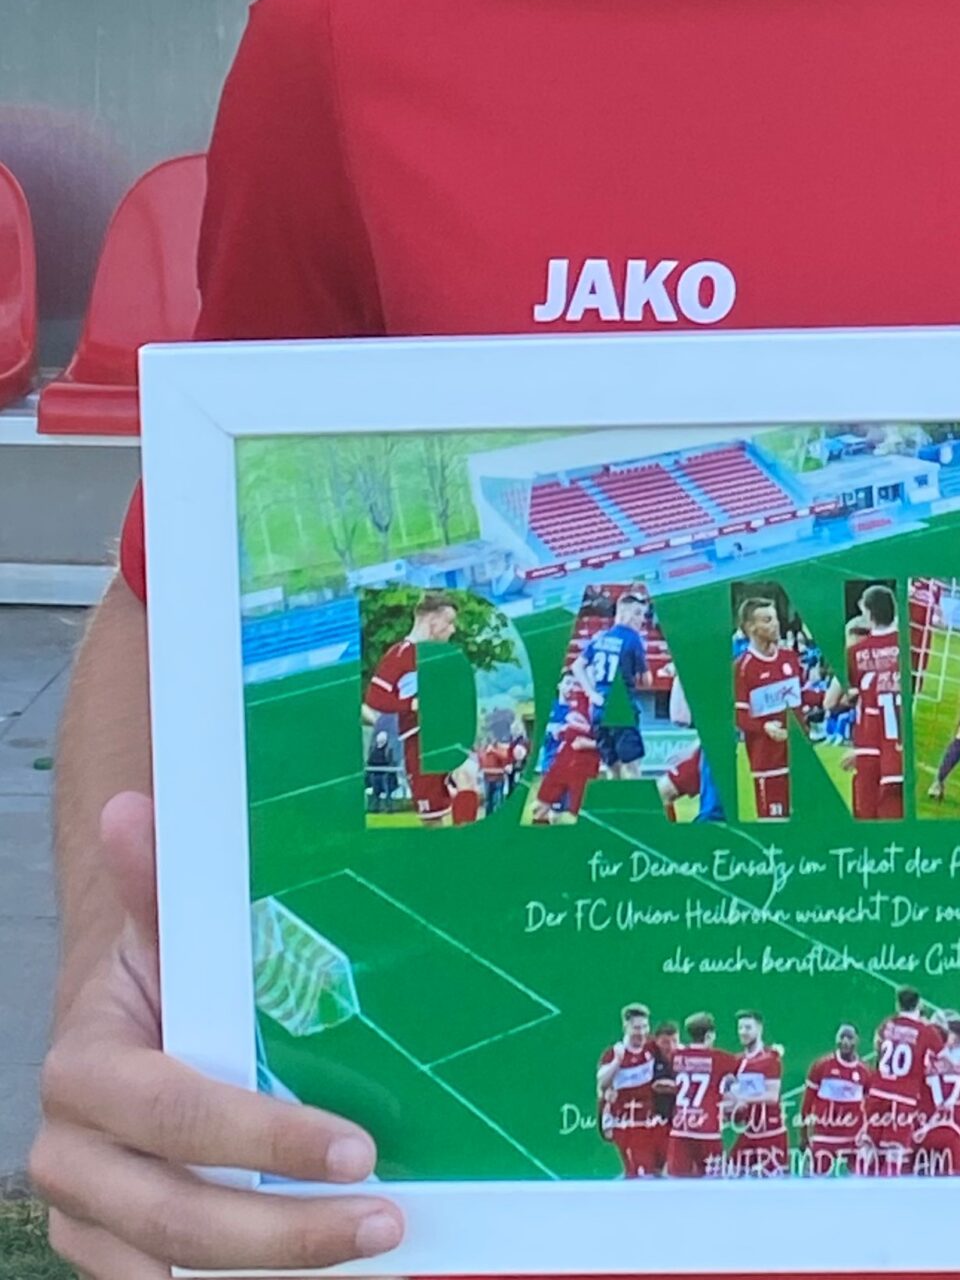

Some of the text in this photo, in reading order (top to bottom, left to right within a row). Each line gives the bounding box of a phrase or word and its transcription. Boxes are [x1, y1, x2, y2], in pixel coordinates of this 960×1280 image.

[533, 258, 737, 324] JAKO
[629, 850, 709, 883] Deinen
[712, 842, 796, 893] Einsatz
[799, 856, 827, 875] im
[829, 841, 905, 890] Trikot
[905, 846, 944, 878] der
[524, 899, 568, 933] Der
[574, 897, 611, 932] FC
[616, 898, 681, 932] Union
[685, 896, 791, 930] Heilbronn
[890, 894, 931, 928] Dir
[662, 944, 696, 975] als
[699, 944, 758, 974] auch
[761, 942, 865, 977] beruflich
[867, 942, 921, 972] alles
[878, 1039, 913, 1078] 20
[675, 1073, 711, 1108] 27
[559, 1103, 598, 1135] Du
